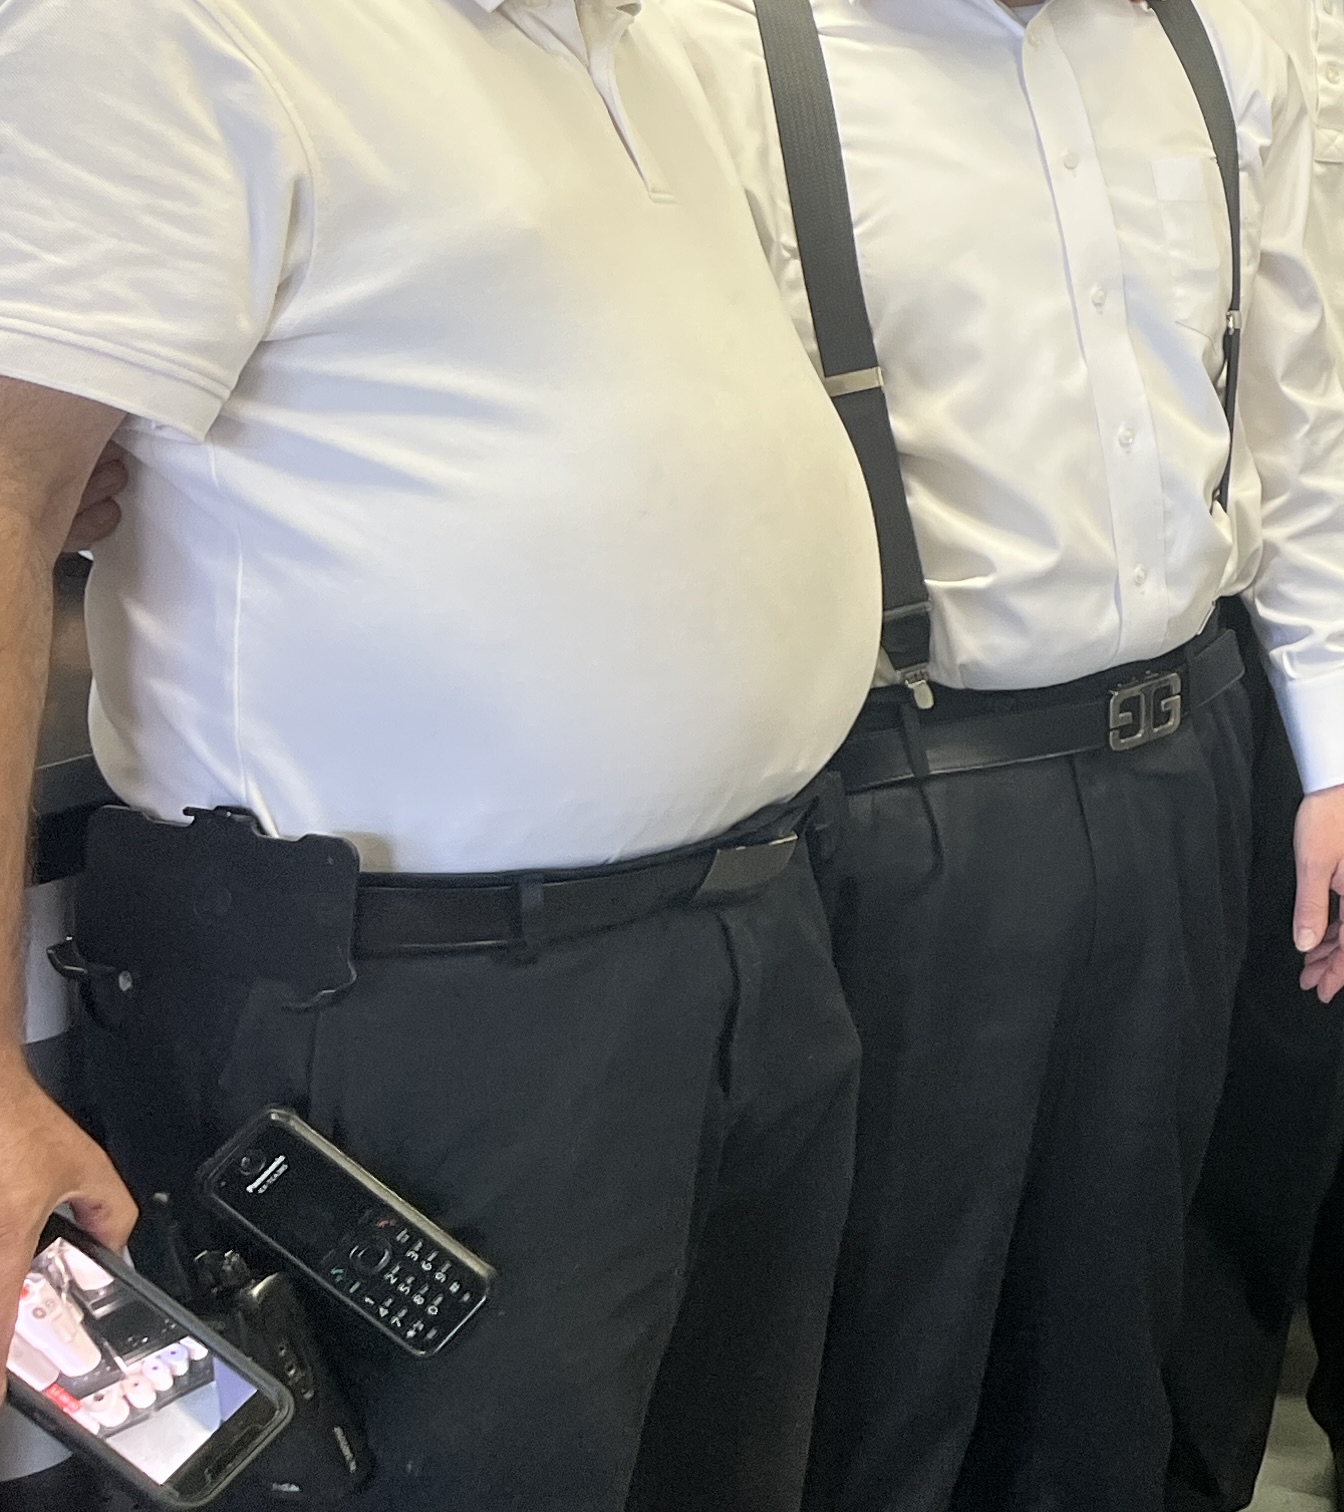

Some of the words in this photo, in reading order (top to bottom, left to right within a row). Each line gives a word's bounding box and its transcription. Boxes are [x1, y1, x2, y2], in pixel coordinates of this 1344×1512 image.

[405, 1250, 419, 1261] 3
[421, 1260, 432, 1271] 6
[386, 1273, 398, 1284] 2
[434, 1272, 446, 1283] 9
[399, 1283, 411, 1295] 5
[365, 1296, 375, 1305] 1
[413, 1295, 425, 1305] 8
[379, 1306, 389, 1317] 4
[427, 1305, 438, 1315] 0
[391, 1316, 401, 1327] 7
